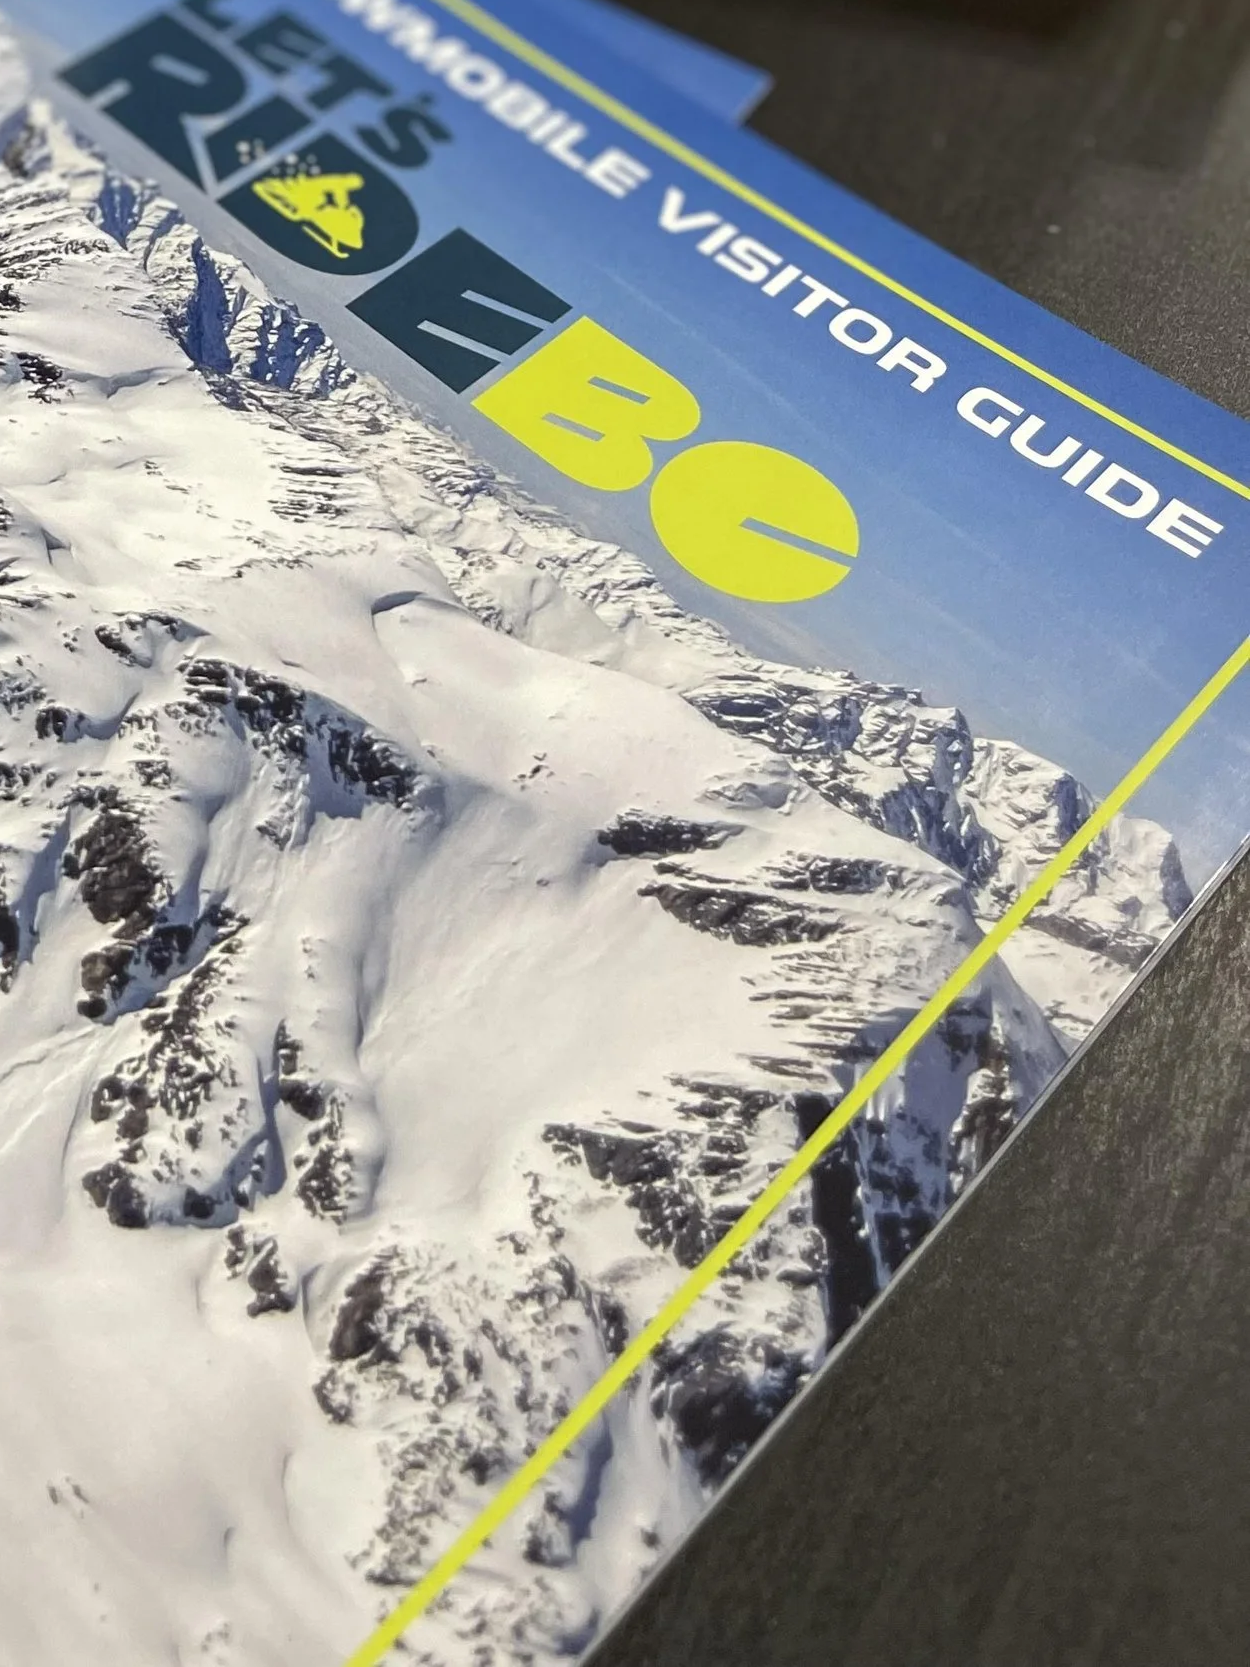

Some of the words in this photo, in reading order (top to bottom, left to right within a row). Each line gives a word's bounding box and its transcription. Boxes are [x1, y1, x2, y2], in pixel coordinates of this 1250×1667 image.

[57, 10, 573, 396] RIDE
[471, 315, 860, 604] BC
[658, 186, 948, 394] VISITOR
[956, 386, 1225, 559] GUIDE
